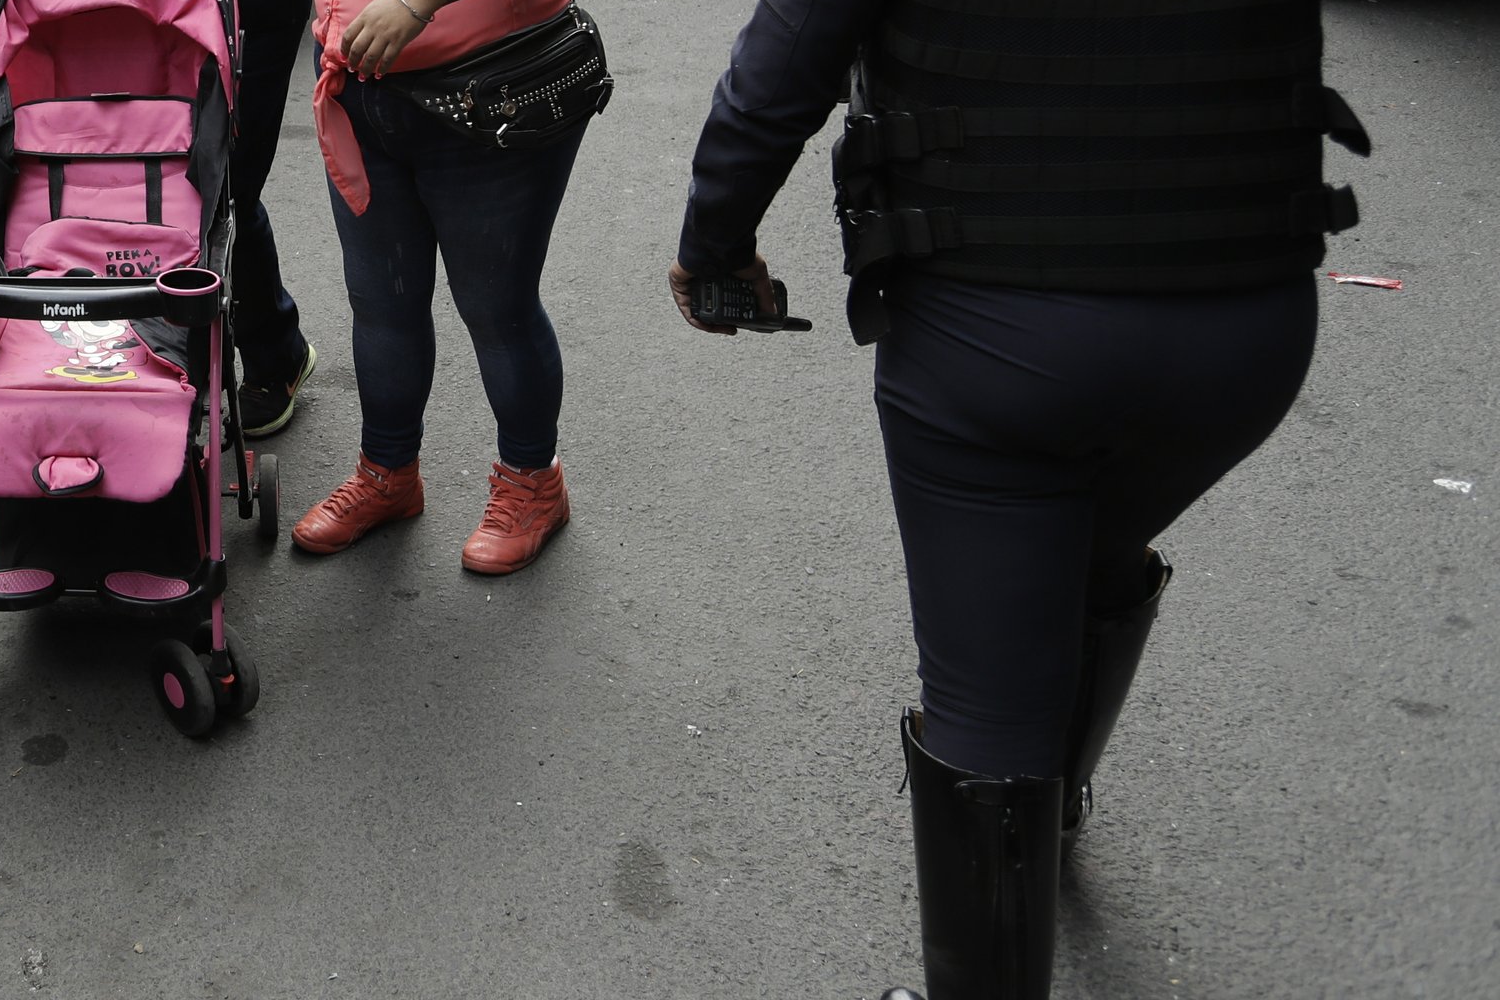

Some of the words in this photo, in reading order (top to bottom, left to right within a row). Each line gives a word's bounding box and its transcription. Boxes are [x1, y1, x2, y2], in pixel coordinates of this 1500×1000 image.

[106, 249, 141, 262] PEEK
[143, 248, 153, 257] A
[105, 256, 161, 277] BOW!
[42, 303, 85, 317] infanti
